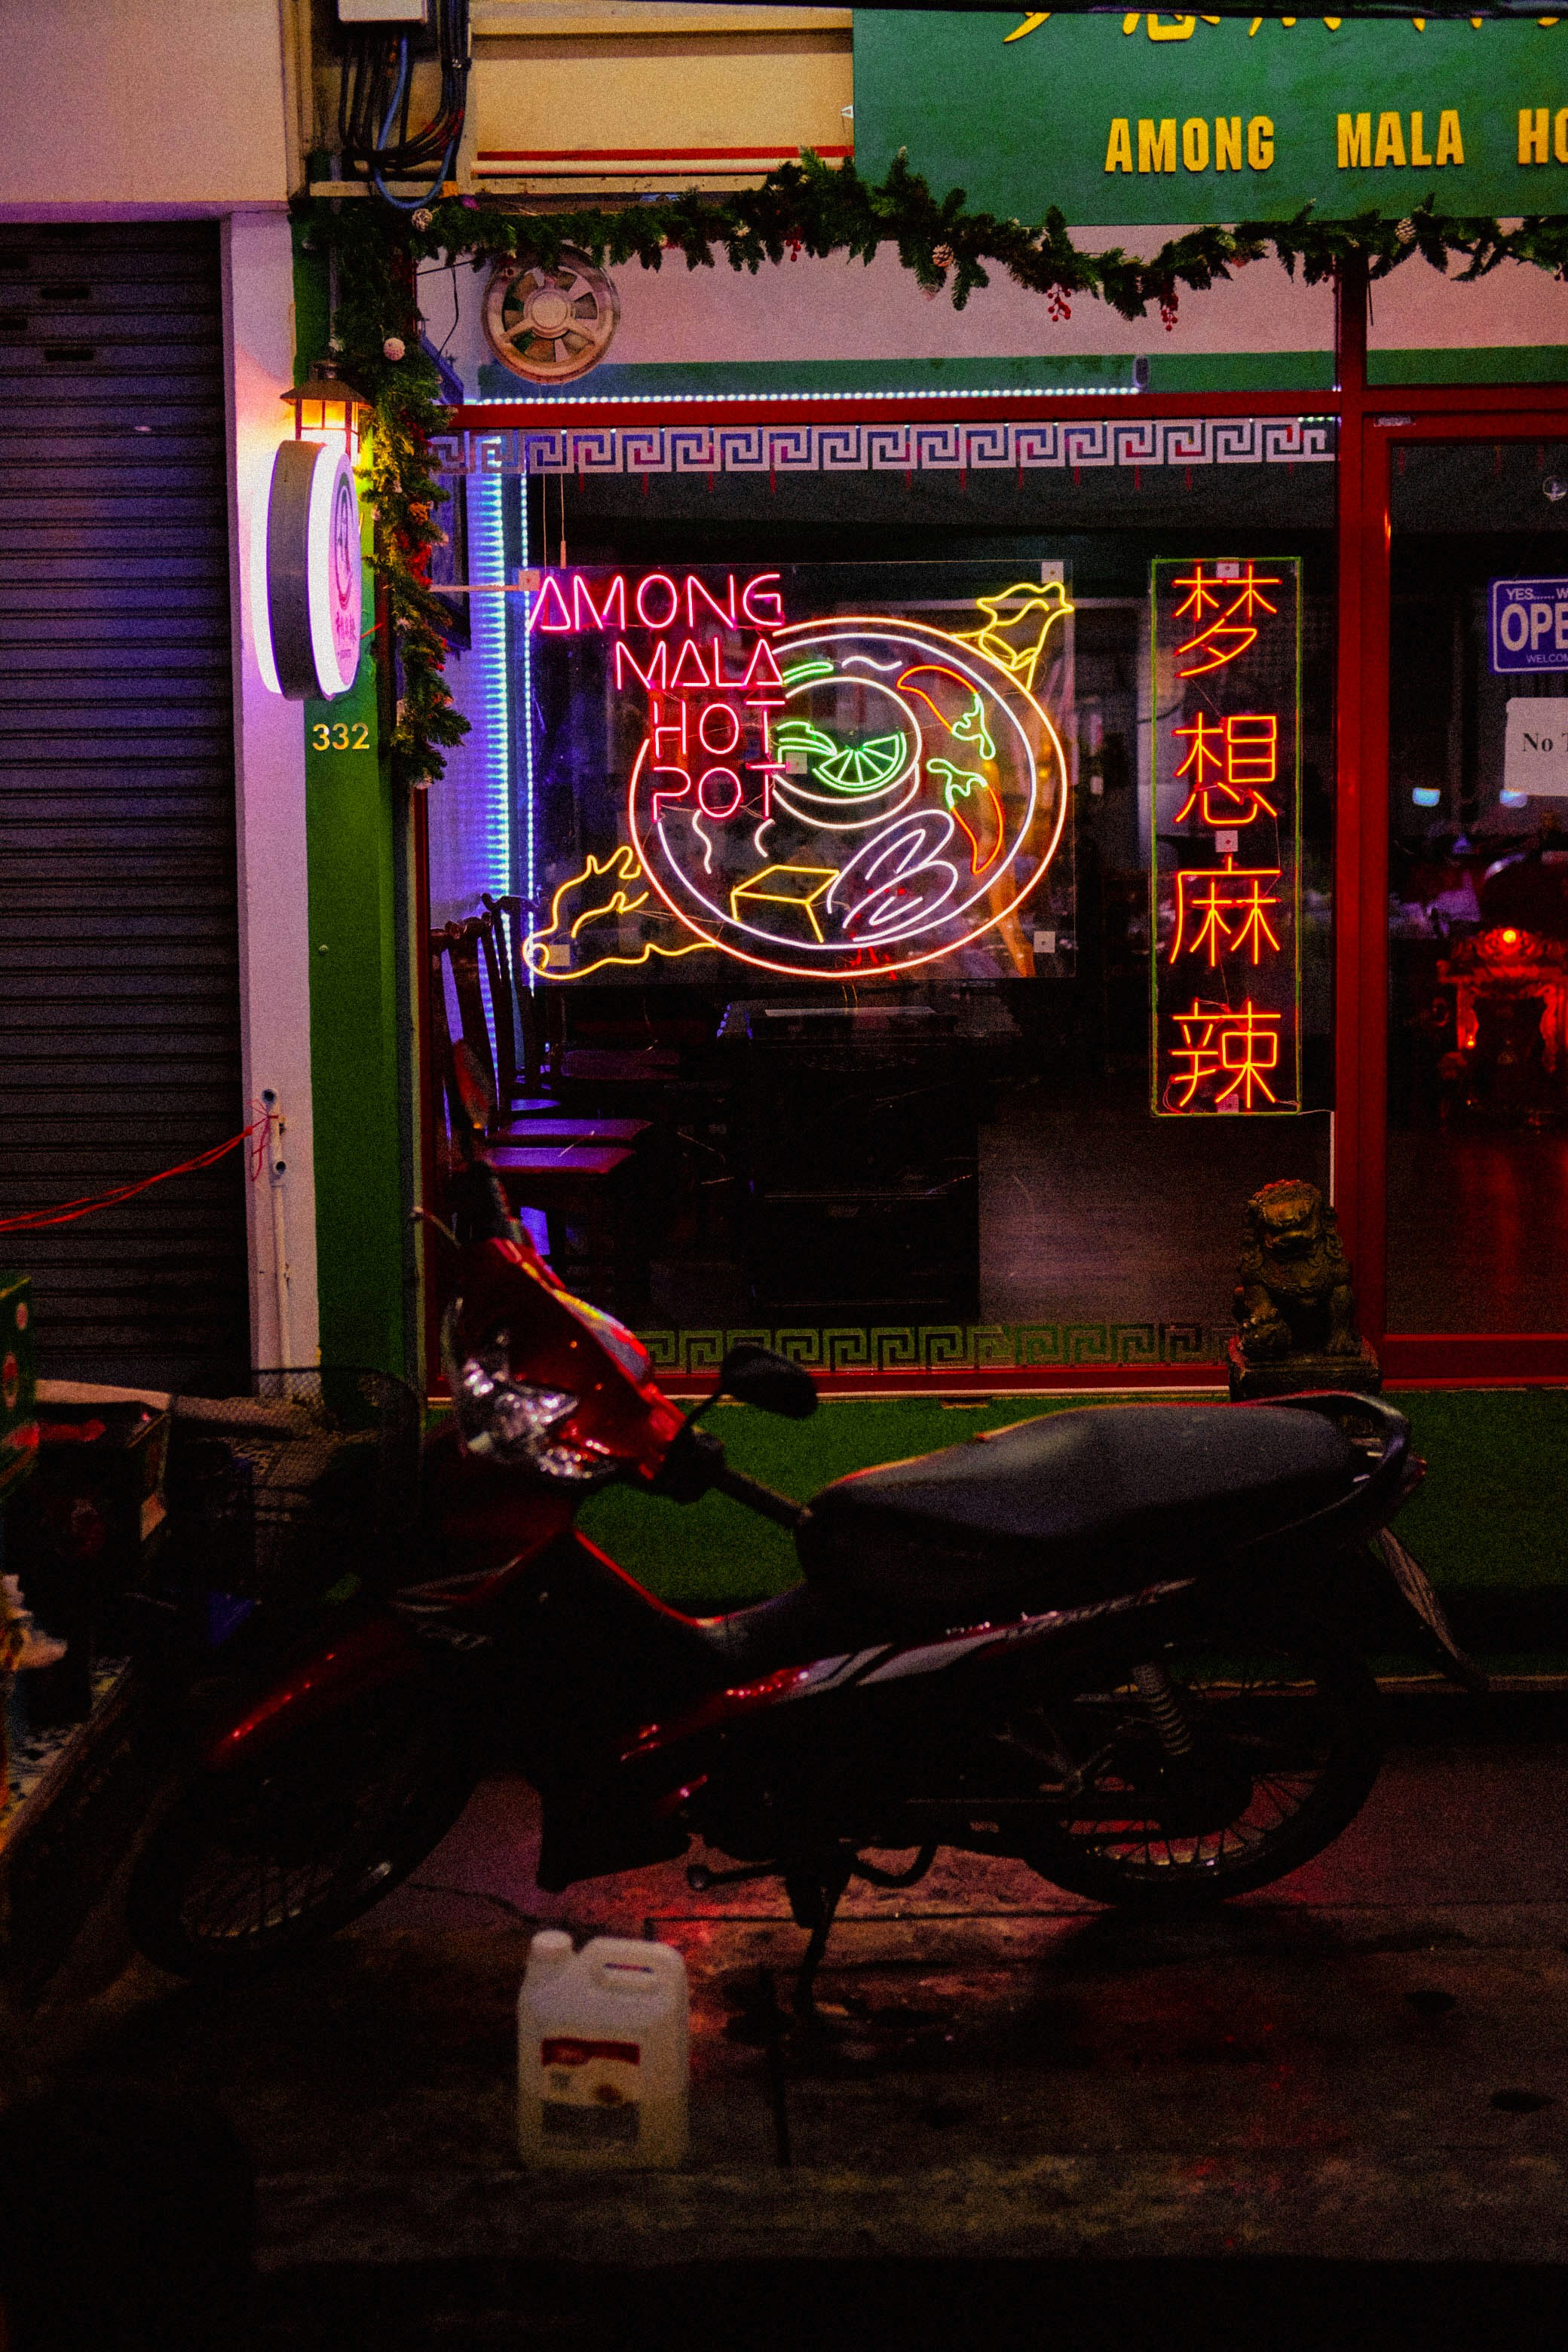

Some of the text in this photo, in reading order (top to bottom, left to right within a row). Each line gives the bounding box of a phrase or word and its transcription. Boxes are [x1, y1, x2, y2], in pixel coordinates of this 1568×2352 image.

[1104, 116, 1274, 173] AMONG
[1337, 109, 1465, 169] MALA
[530, 573, 785, 631] AMONG
[614, 637, 784, 690] MALA
[311, 722, 370, 751] 332
[653, 699, 786, 759] HOT
[1521, 733, 1554, 752] No
[651, 762, 788, 822] POT
[1169, 563, 1282, 1110] 梦想麻辣
